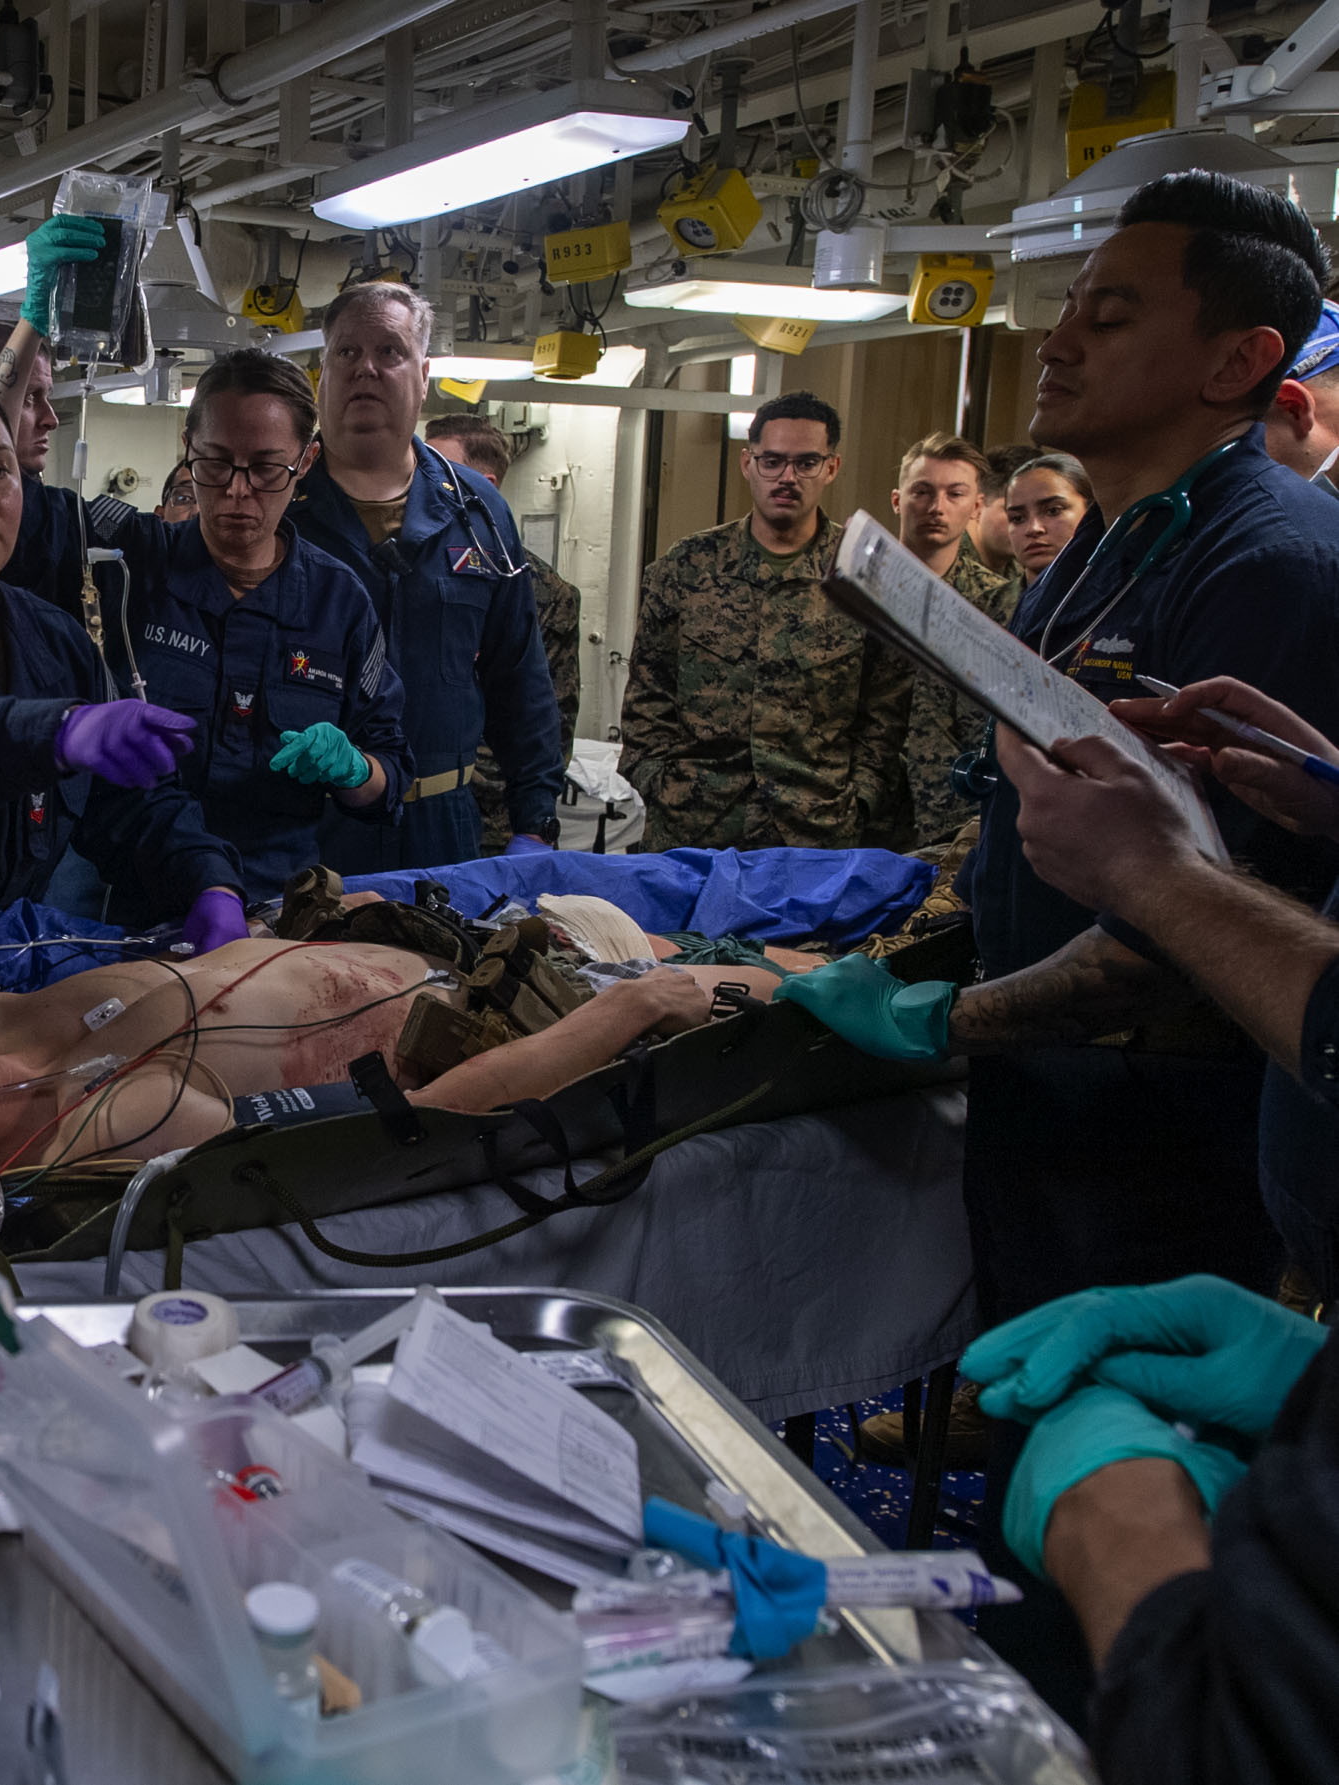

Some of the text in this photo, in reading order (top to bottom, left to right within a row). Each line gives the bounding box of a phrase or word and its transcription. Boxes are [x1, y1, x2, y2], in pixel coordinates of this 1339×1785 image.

[1084, 145, 1112, 161] R9
[552, 243, 592, 261] R933
[144, 623, 210, 657] U.S. NAVY
[1117, 671, 1132, 680] USN
